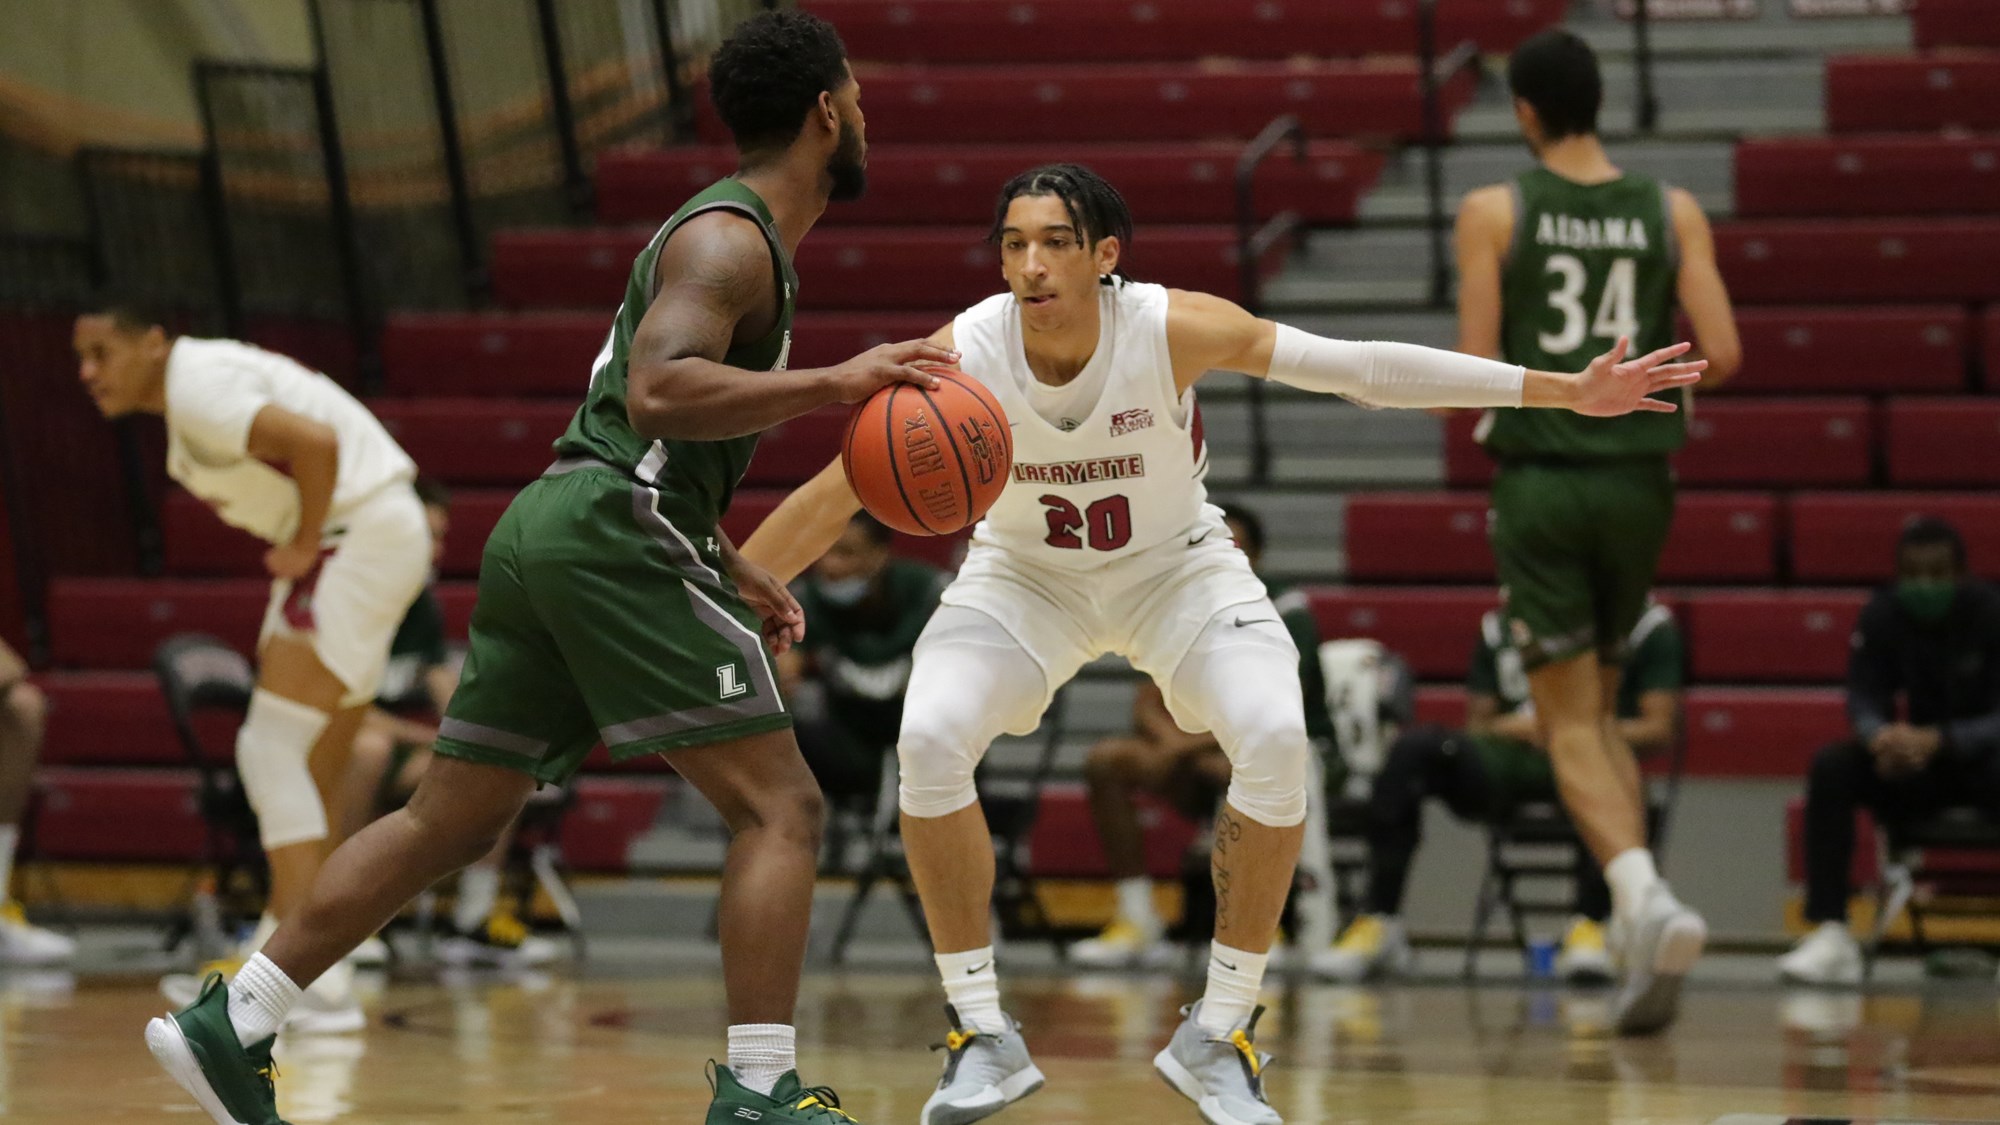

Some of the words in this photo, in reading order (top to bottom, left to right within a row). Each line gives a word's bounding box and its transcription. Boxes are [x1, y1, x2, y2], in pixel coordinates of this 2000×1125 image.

[1537, 253, 1640, 358] 34
[1012, 453, 1145, 485] LAFAYETTE
[918, 480, 959, 521] THE
[1038, 493, 1132, 552] 20
[716, 663, 747, 700] L
